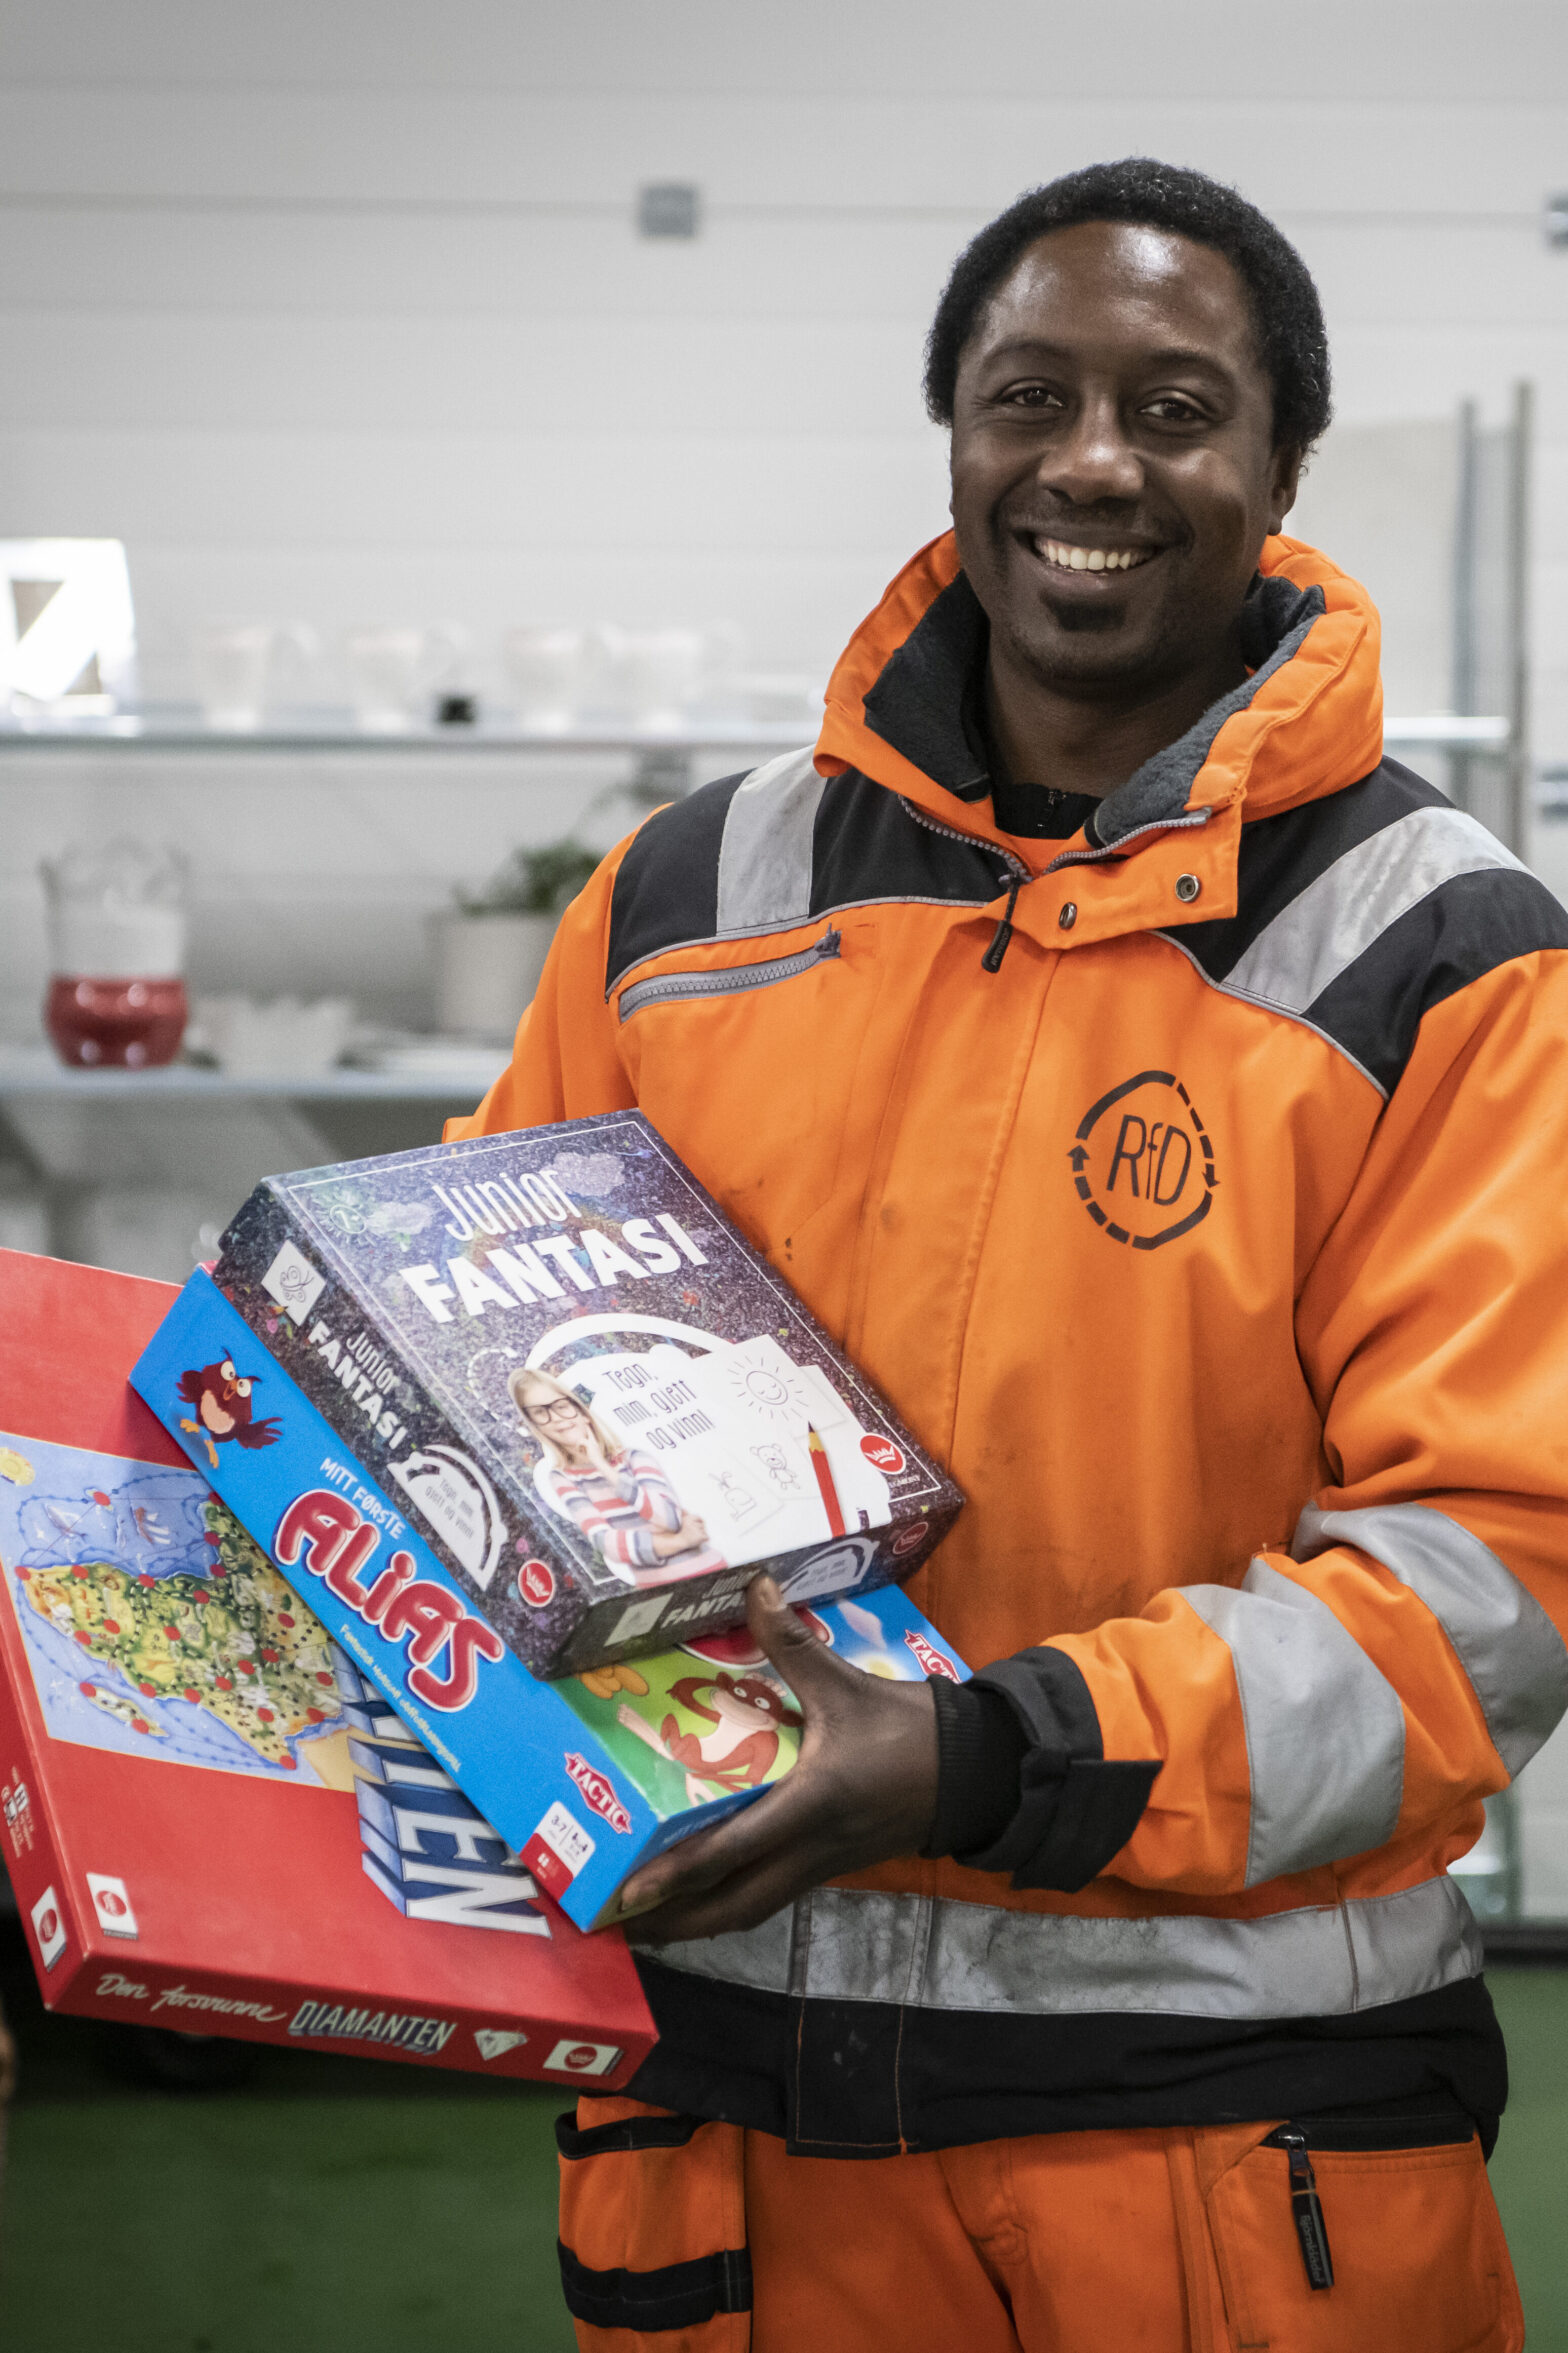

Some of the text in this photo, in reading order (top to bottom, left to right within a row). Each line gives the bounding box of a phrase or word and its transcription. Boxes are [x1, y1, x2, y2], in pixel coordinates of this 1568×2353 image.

[1106, 1114, 1192, 1207] RfD
[398, 1212, 709, 1324] FANTASI
[307, 1319, 409, 1451] FANTASI
[601, 1362, 659, 1393] Tegn,
[650, 1378, 698, 1414] gjett
[646, 1426, 677, 1451] og
[319, 1456, 359, 1492] MITT
[352, 1485, 407, 1541] FØRSTE
[660, 1589, 747, 1630] FANTA
[569, 1757, 629, 1832] TACTIC
[96, 1973, 458, 2054] Den forsvunne DIAMANTEN
